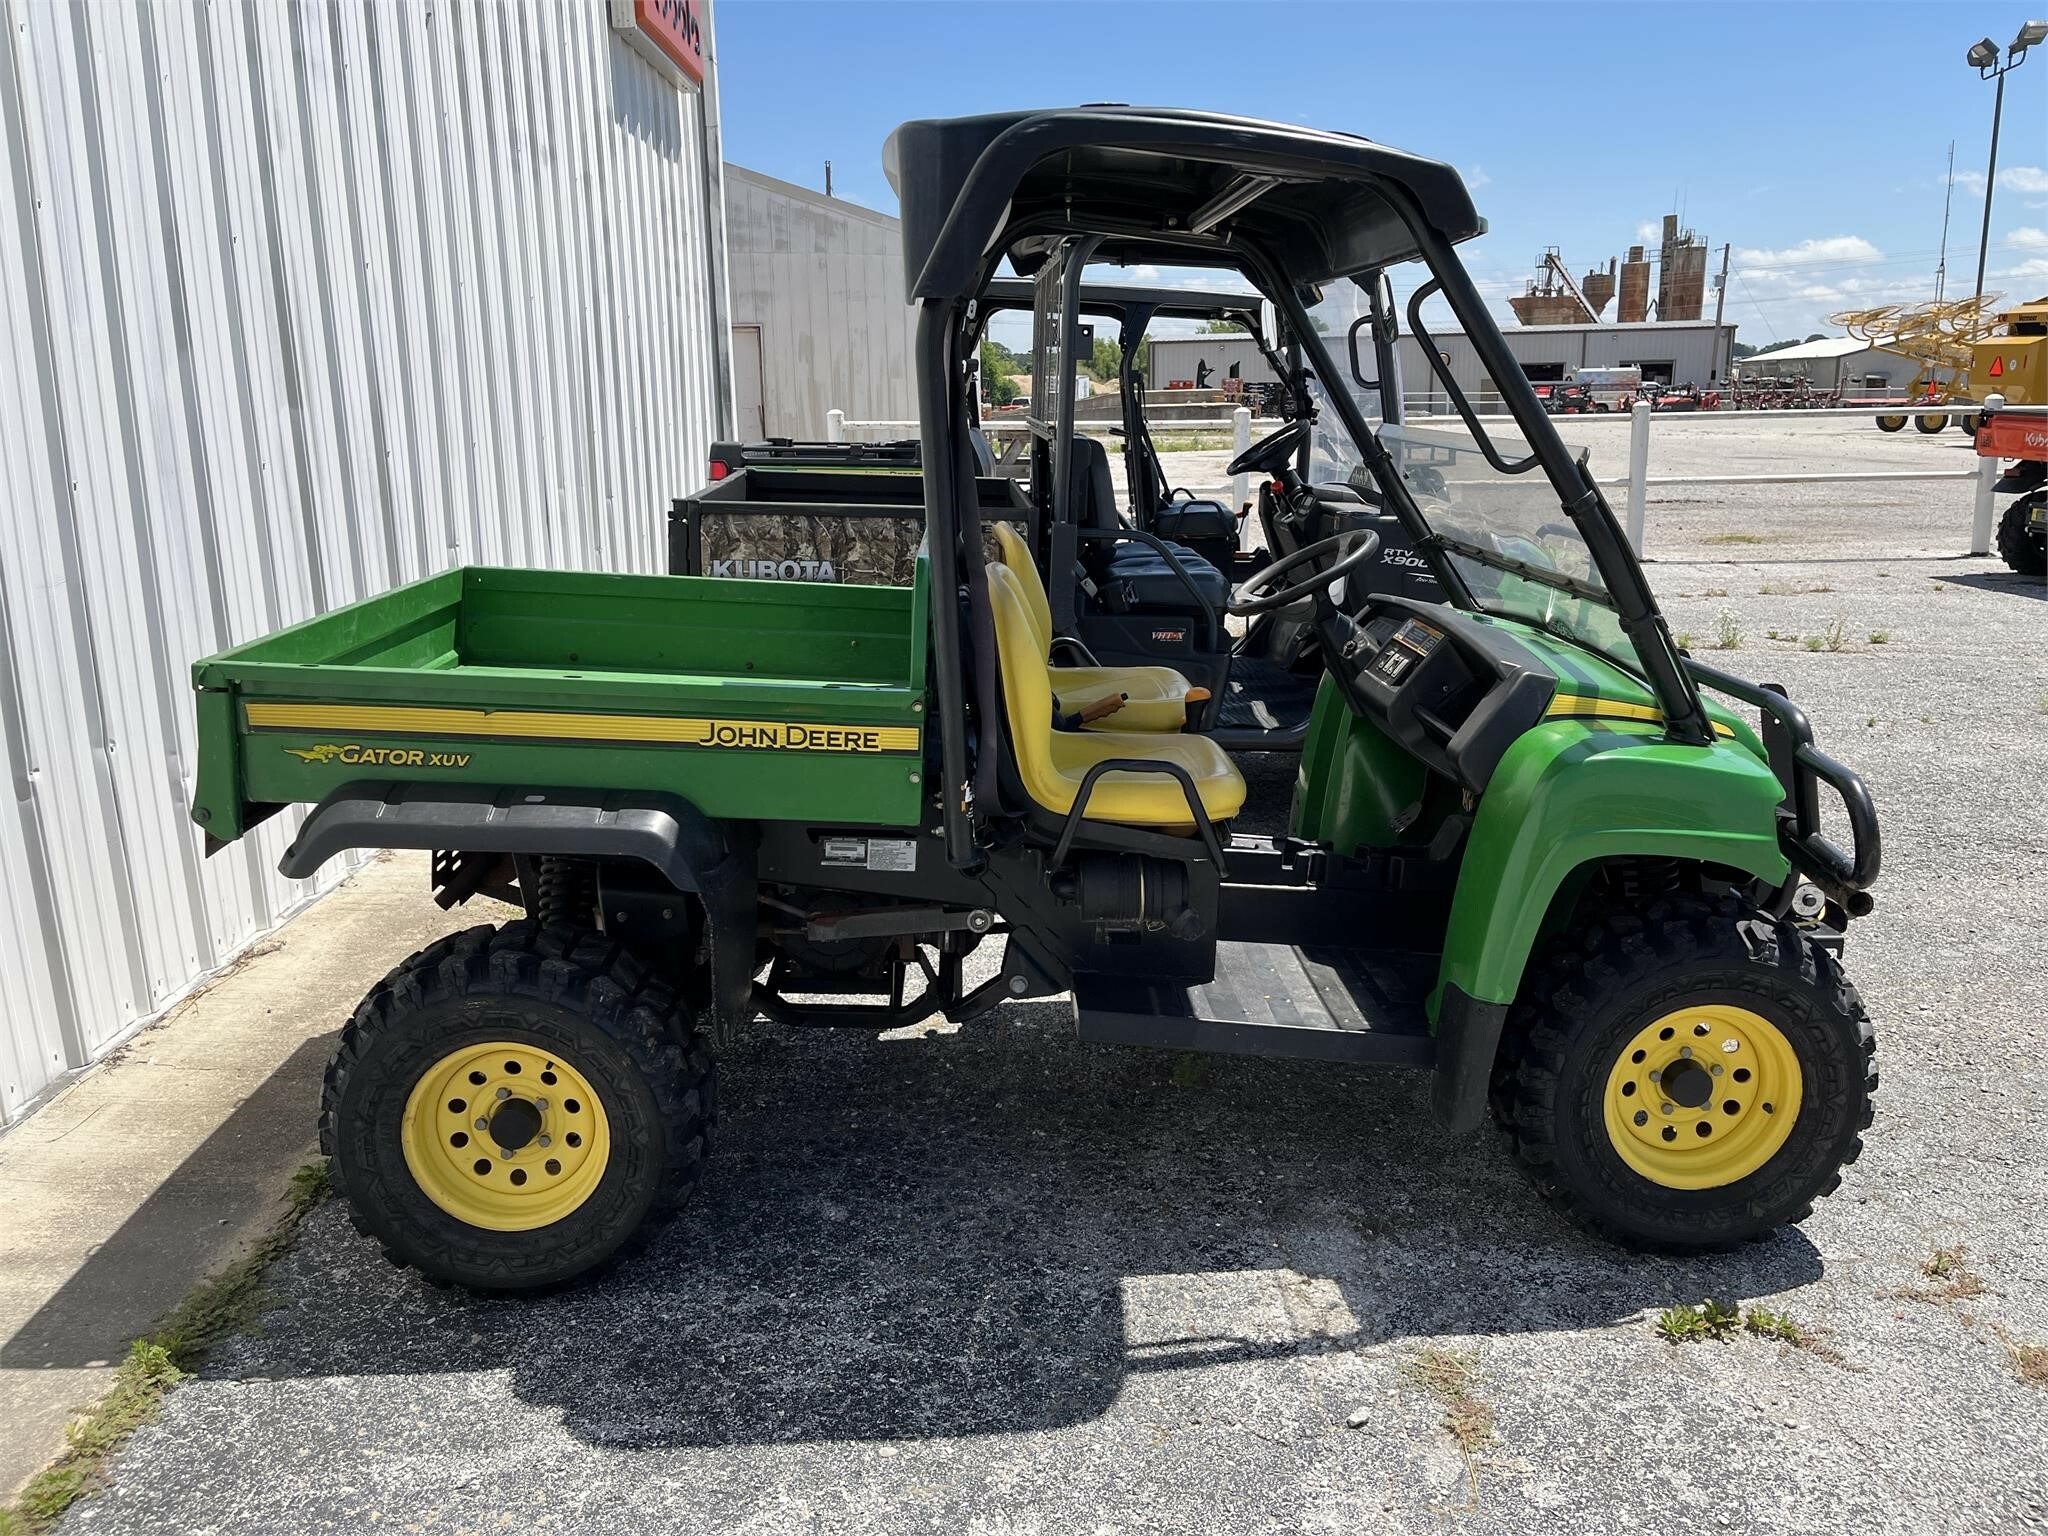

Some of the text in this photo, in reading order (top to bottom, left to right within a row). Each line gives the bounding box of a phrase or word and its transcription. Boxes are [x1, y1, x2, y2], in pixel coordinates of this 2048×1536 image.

[1383, 548, 1414, 557] RTV
[713, 559, 837, 581] KUBOTA
[699, 722, 880, 749] JOHN DEERE
[339, 745, 470, 767] GATOR XUV
